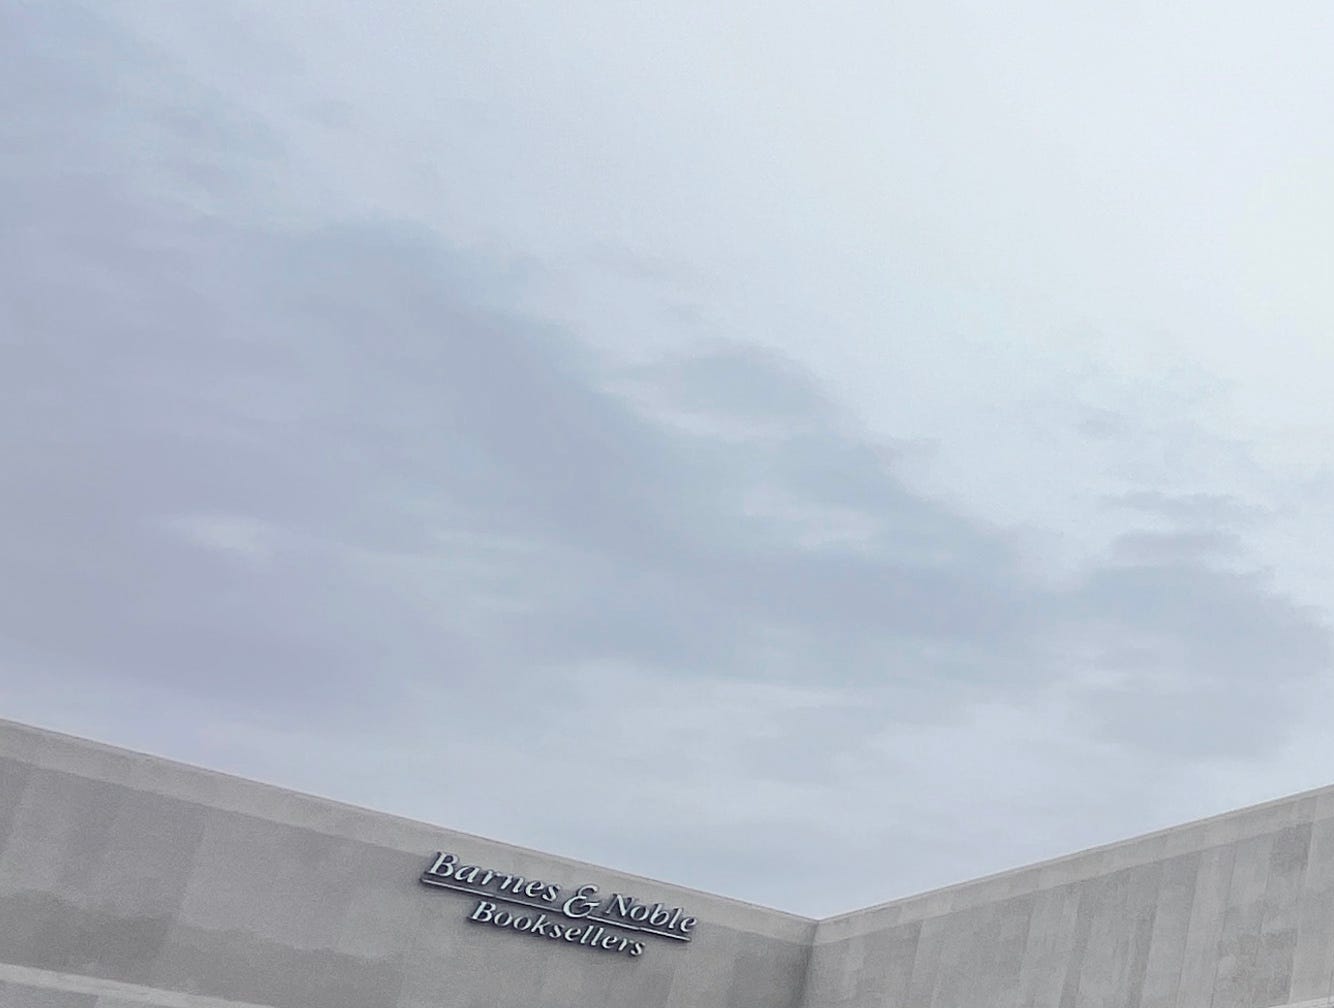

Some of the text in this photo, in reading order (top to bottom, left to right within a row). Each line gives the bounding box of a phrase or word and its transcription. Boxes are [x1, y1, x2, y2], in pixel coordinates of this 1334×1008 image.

[428, 852, 697, 932] Barnes & Noble
[471, 901, 645, 956] Booksellers
